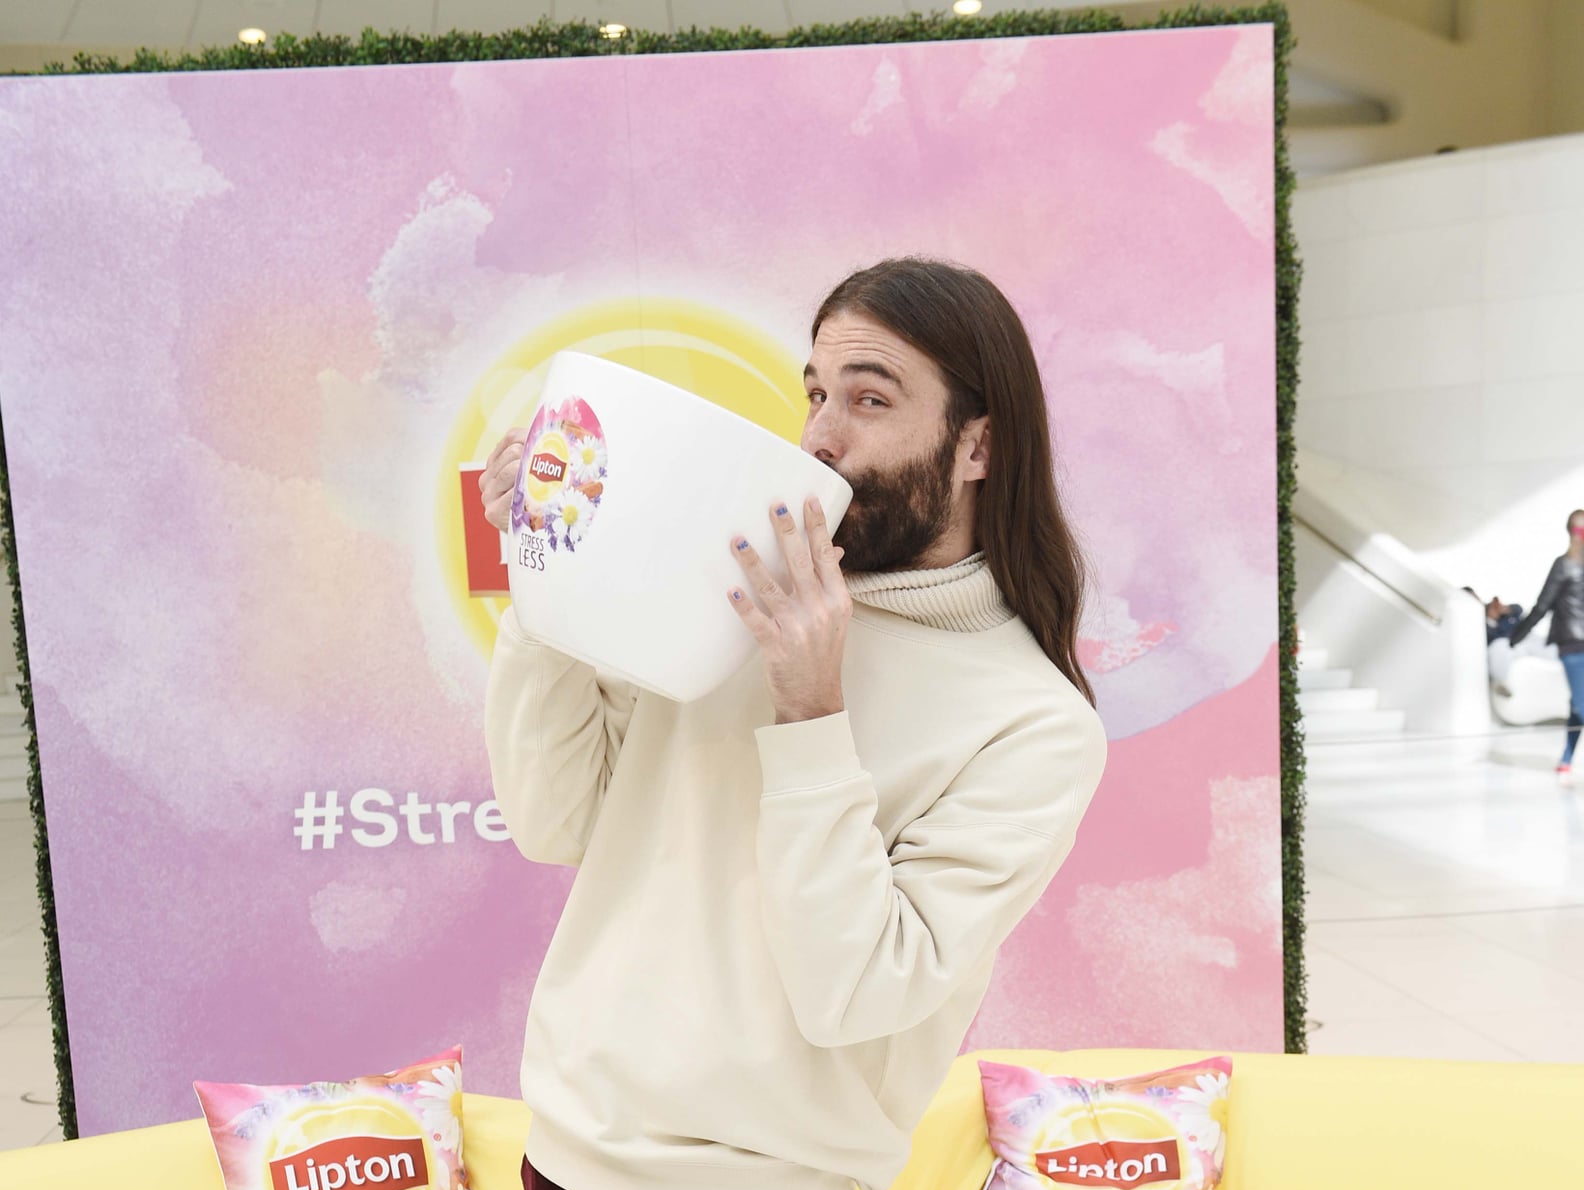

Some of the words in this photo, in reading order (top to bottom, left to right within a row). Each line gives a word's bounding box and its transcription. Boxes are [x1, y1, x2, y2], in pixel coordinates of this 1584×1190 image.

[532, 456, 562, 478] Lipton
[520, 532, 545, 551] STRESS
[519, 546, 545, 572] LESS
